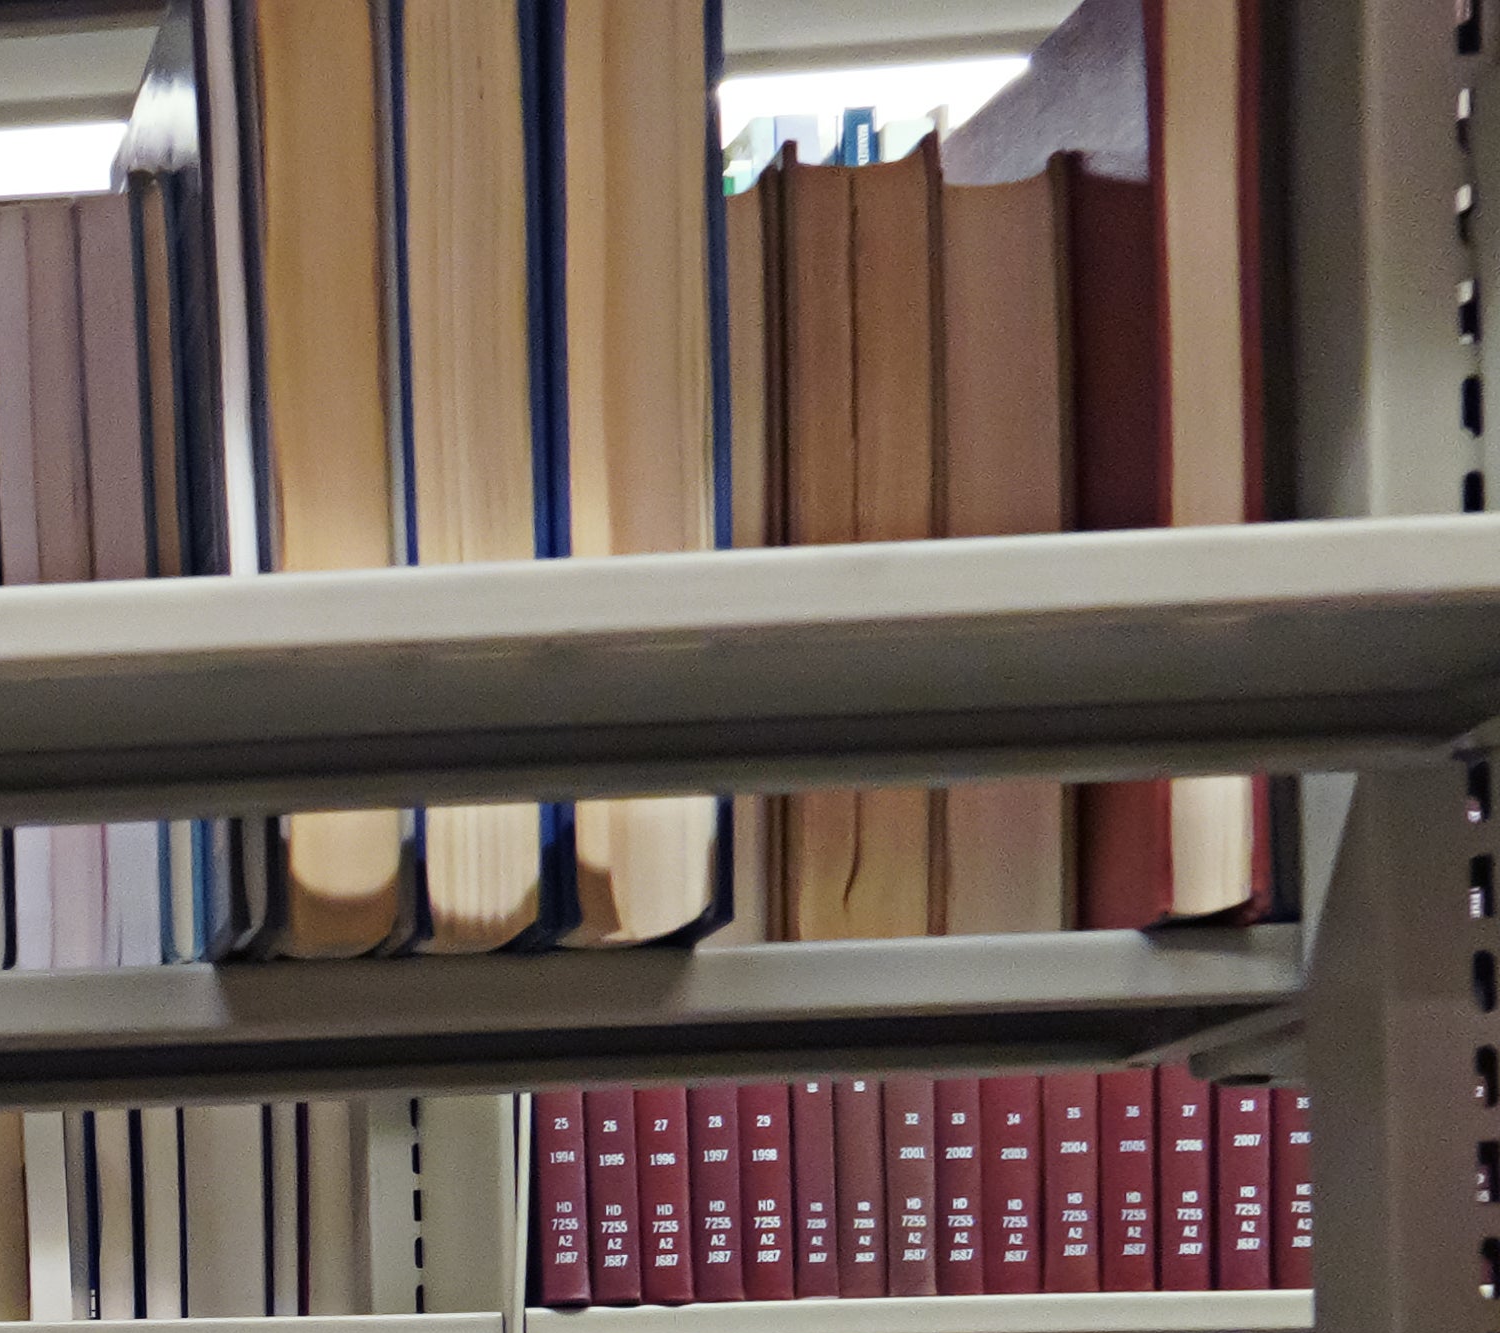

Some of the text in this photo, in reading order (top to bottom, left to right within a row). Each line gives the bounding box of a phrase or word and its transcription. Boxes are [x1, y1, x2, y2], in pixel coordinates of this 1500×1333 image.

[554, 1117, 569, 1129] 25
[653, 1119, 668, 1131] 27
[708, 1115, 723, 1128] 28
[756, 1115, 771, 1127] 29
[550, 1151, 575, 1163] 1994
[703, 1149, 729, 1162] 1997
[556, 1201, 572, 1213] HD
[551, 1218, 579, 1230] 7255
[558, 1235, 573, 1247] A2
[555, 1252, 578, 1264] J687
